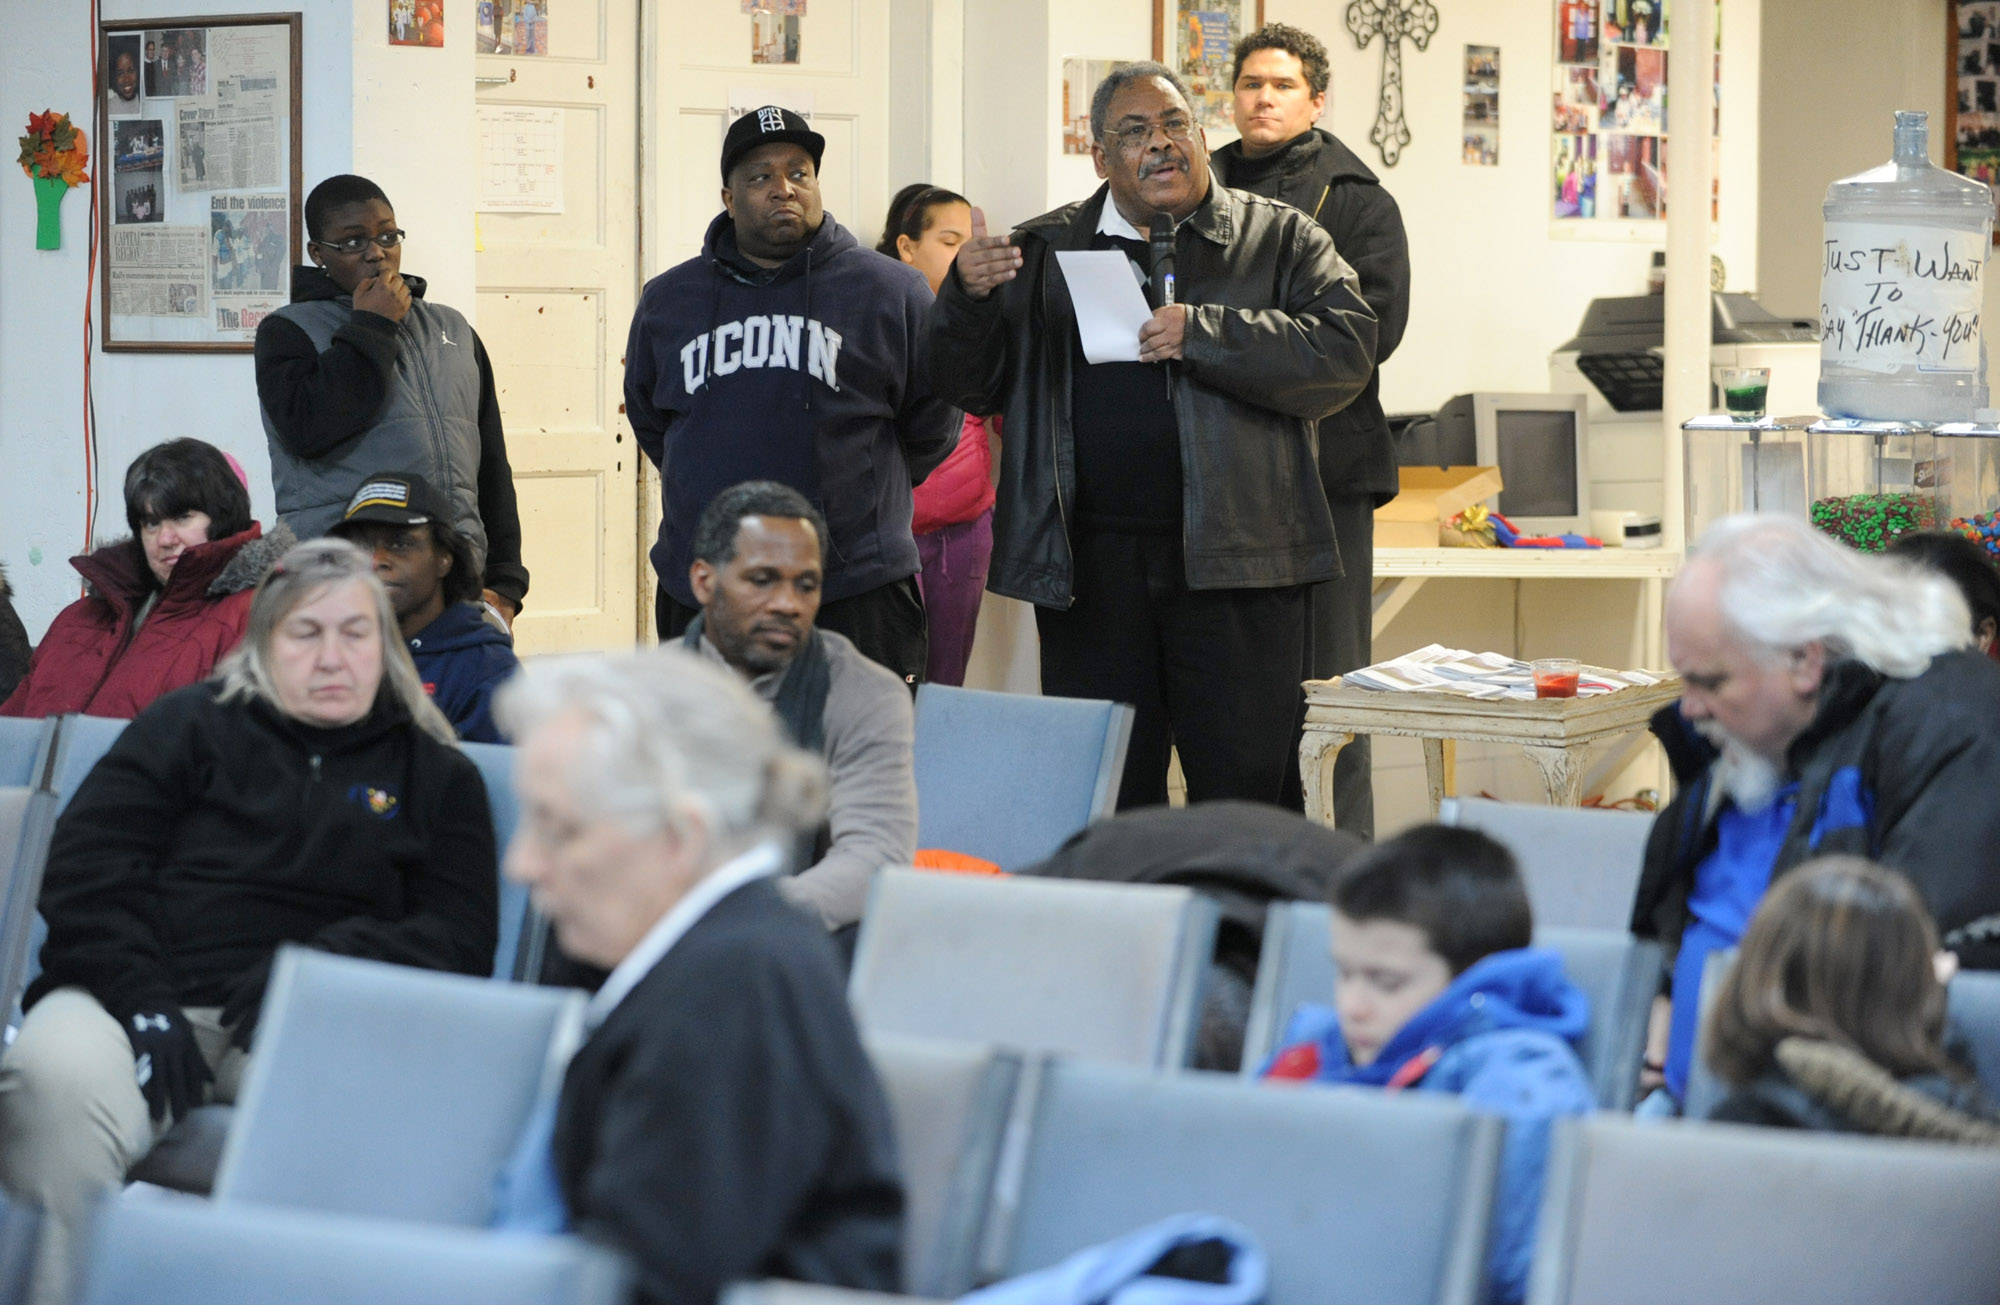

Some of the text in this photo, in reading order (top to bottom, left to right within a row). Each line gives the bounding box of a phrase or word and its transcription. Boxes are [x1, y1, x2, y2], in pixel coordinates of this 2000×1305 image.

[179, 107, 215, 121] Cover Story
[211, 195, 286, 210] End the violence
[114, 231, 140, 246] CAPITAL
[115, 246, 140, 262] REGION
[1823, 240, 1982, 281] JUST WANT
[1864, 281, 1903, 305] TO
[221, 308, 239, 328] The
[680, 314, 843, 394] UCONN
